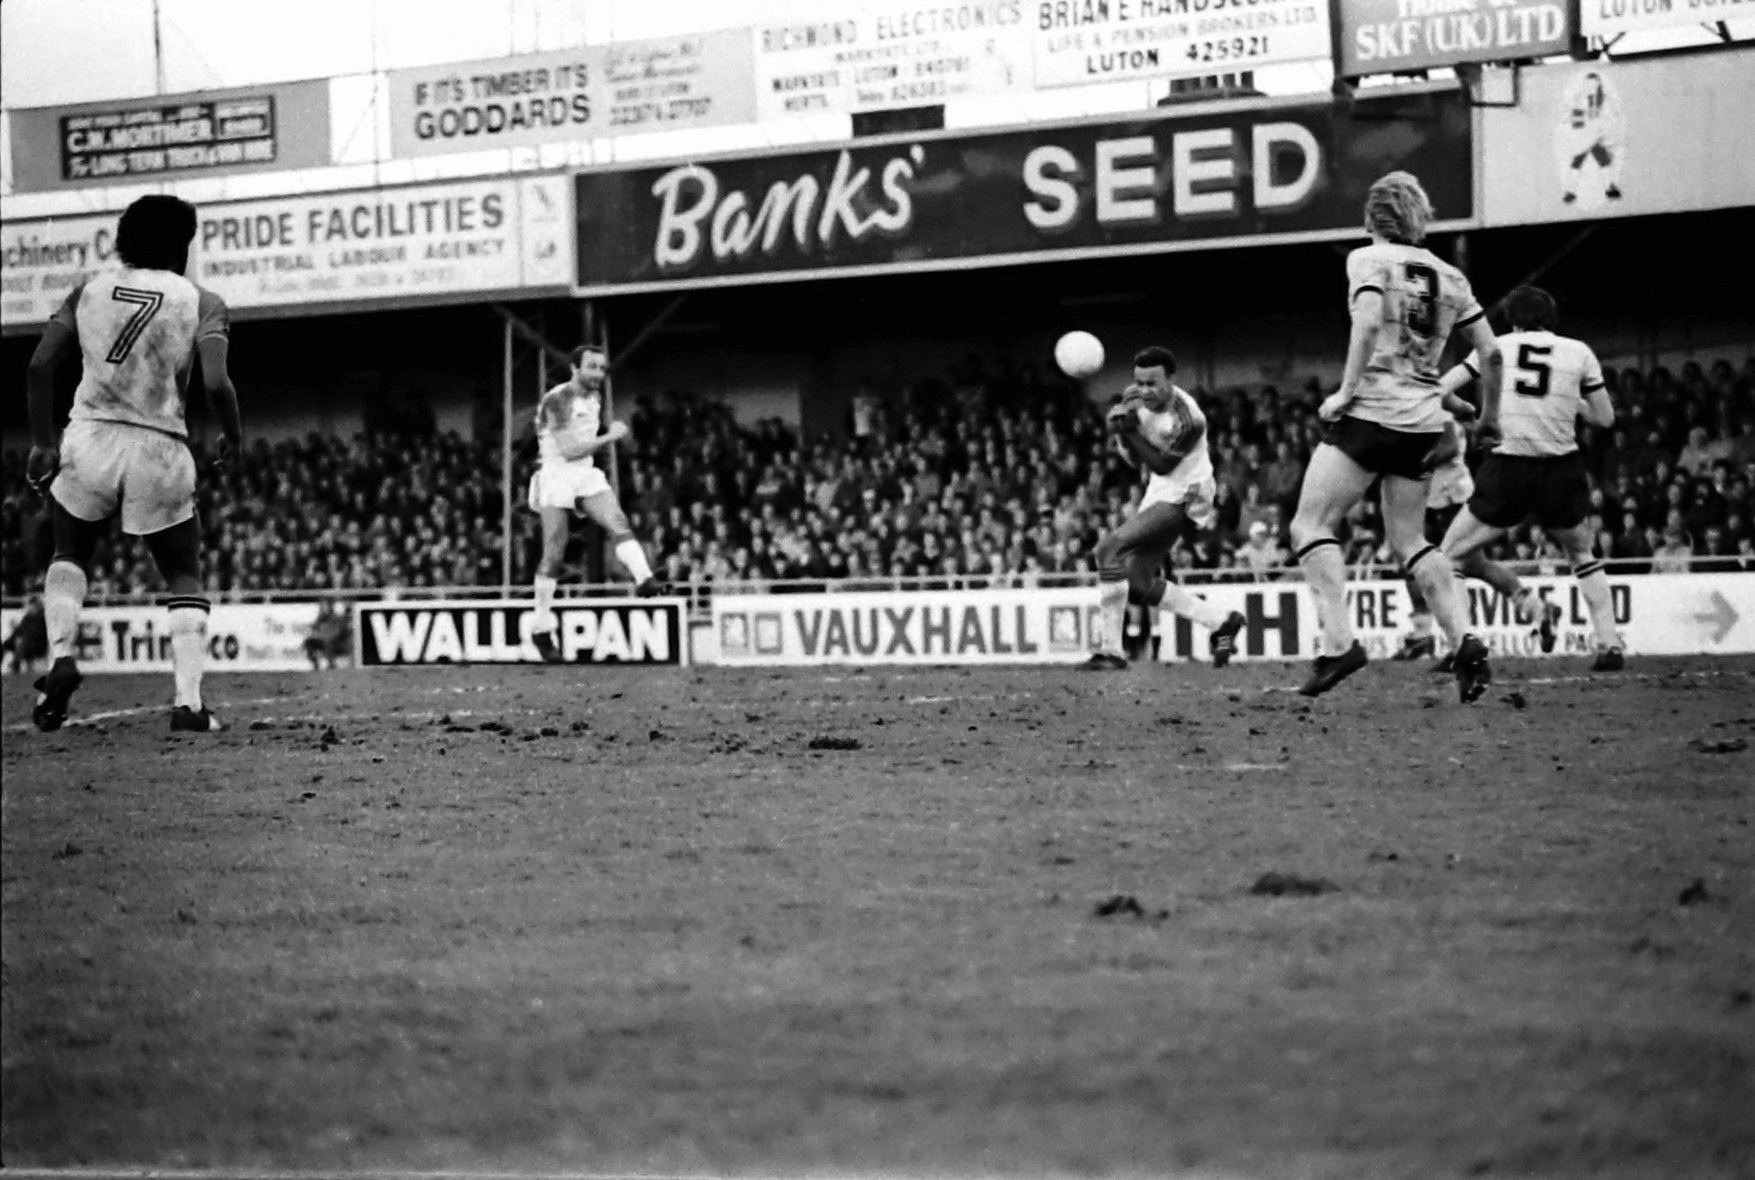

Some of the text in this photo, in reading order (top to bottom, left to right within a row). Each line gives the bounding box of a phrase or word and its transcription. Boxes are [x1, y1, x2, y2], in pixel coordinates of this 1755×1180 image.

[876, 0, 1022, 40] ELECTRONICS
[1039, 0, 1108, 30] BRIAN
[1087, 36, 1270, 74] LUTON 425921
[413, 93, 592, 141] GODDARDS
[1023, 122, 1321, 229] SEED
[202, 193, 504, 251] PRIDE FACILITIES
[204, 254, 314, 278] INDUSTRIAL
[425, 238, 504, 261] AGENCY
[105, 285, 165, 364] 7
[1405, 261, 1438, 339] 3
[1515, 343, 1551, 397] 5
[794, 604, 1039, 656] VAUXHALL
[1570, 584, 1631, 626] LD
